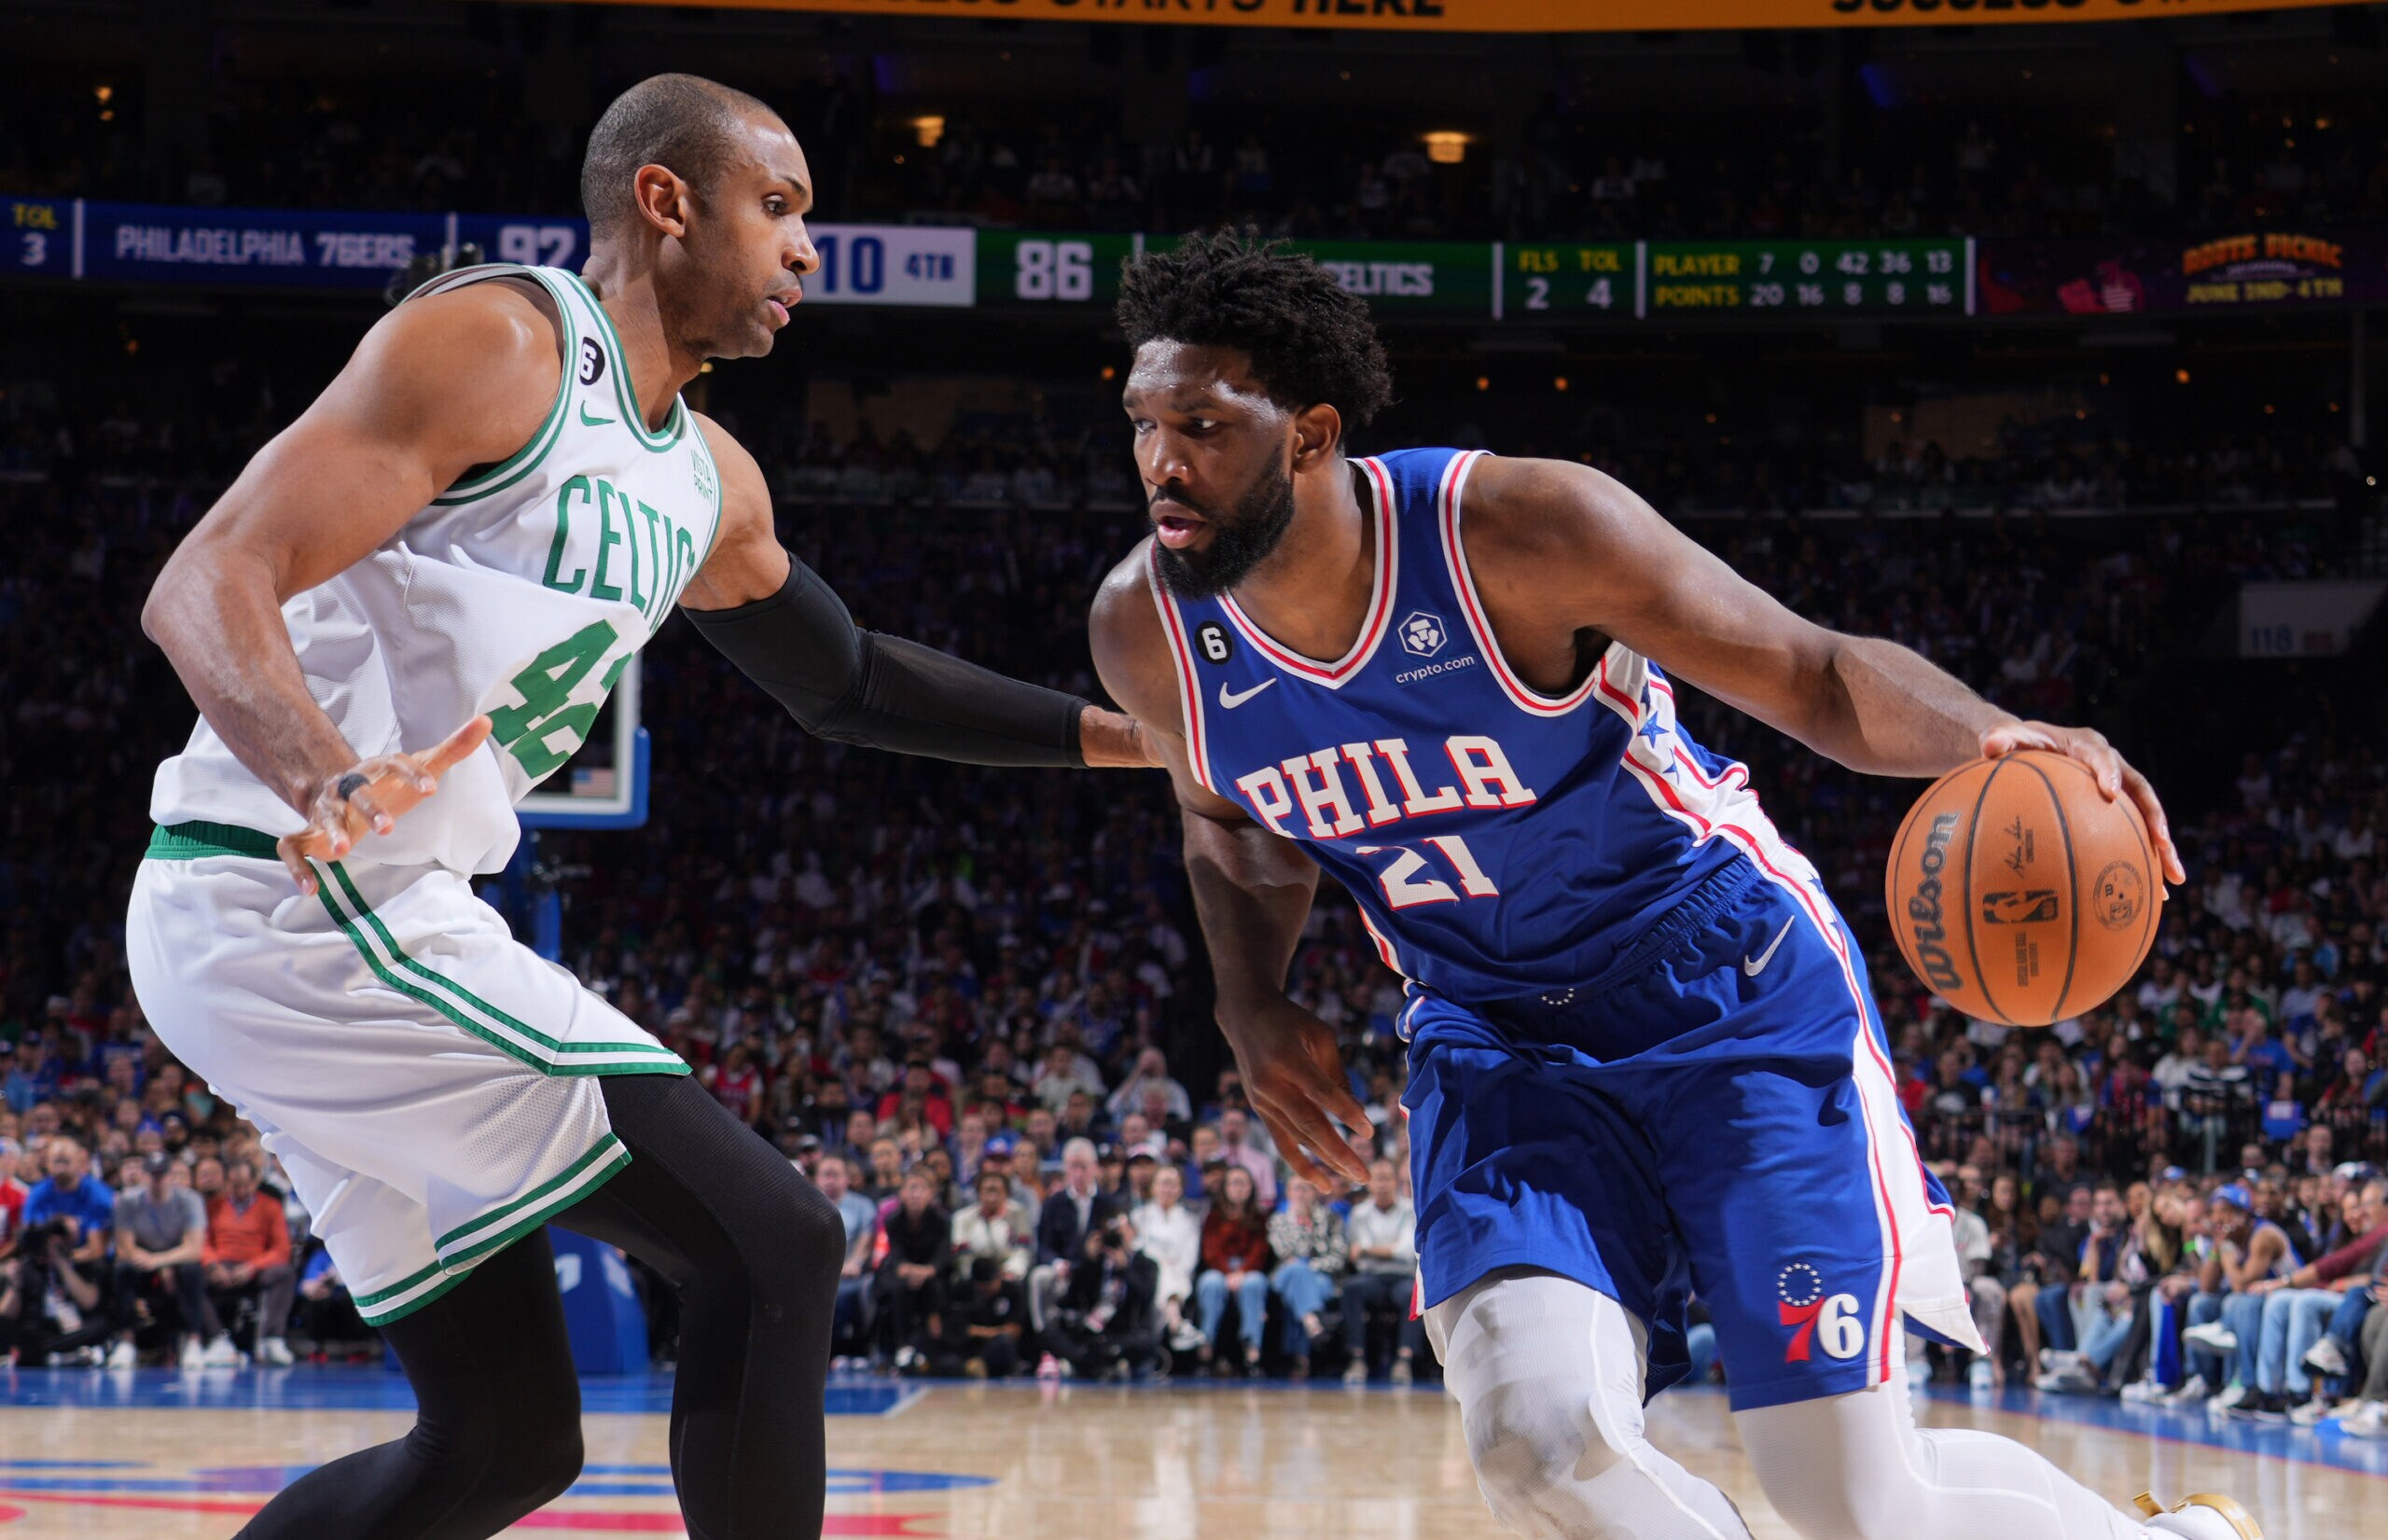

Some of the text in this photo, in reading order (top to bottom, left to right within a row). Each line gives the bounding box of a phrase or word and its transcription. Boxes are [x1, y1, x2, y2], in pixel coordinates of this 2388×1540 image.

[12, 202, 58, 229] TOL
[21, 231, 47, 266] 3
[116, 224, 417, 269] PHILADELPHIA 76ERS
[498, 224, 576, 267] 92
[1518, 248, 1622, 271] FLS TOL
[1653, 249, 1953, 277] PLAYER 7 0 42 36 13
[904, 253, 955, 280] 4TH
[1016, 239, 1093, 301] 86
[1525, 276, 1613, 310] 2 4
[1654, 284, 1741, 308] POINTS
[1749, 282, 1785, 308] 20
[1796, 283, 1826, 307] 16
[580, 340, 596, 381] 6
[543, 475, 696, 635] CELTIC
[1201, 626, 1228, 661] 6
[1395, 656, 1476, 684] crypto.com
[485, 618, 635, 780] 42
[1235, 735, 1538, 840] PHILA
[1355, 835, 1500, 911] 21
[1908, 812, 1964, 993] Wilson
[1778, 1293, 1865, 1364] 76
